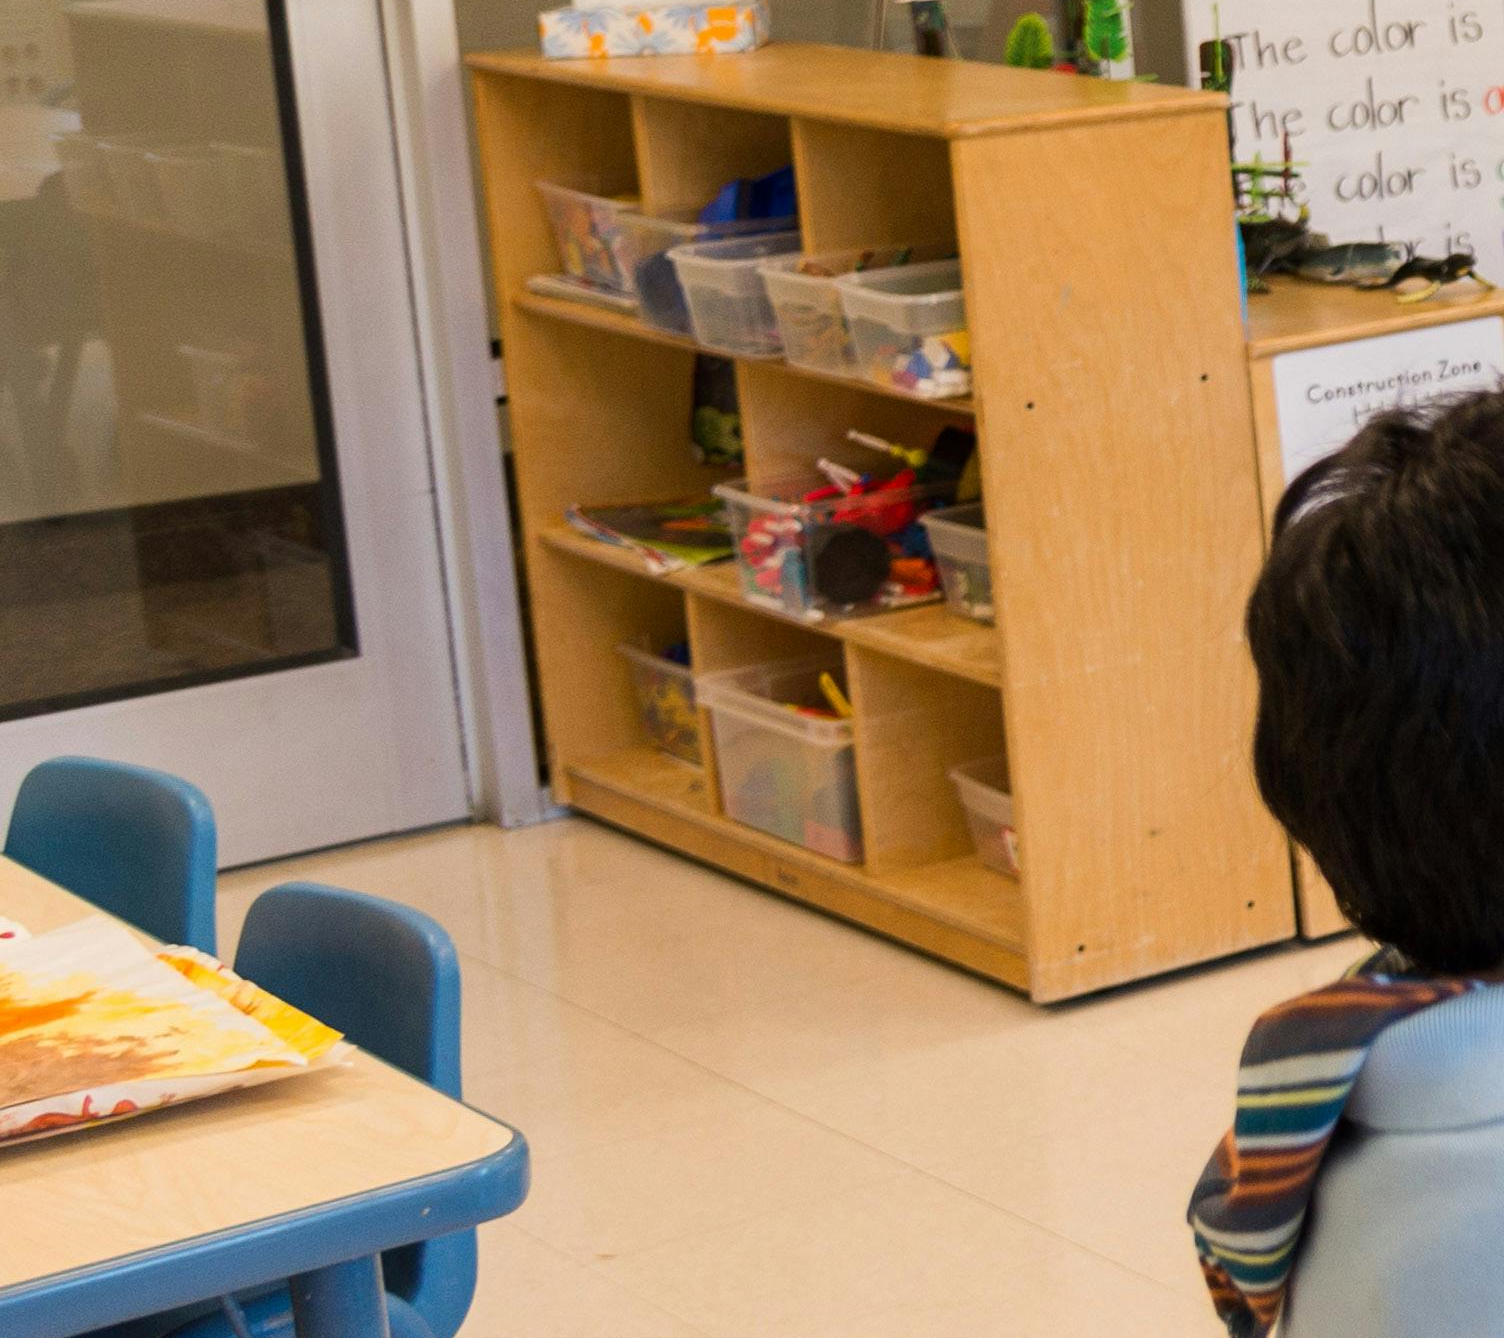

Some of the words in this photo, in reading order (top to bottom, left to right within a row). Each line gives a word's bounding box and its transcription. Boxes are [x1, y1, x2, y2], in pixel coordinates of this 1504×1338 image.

[1228, 31, 1309, 69] The
[1448, 2, 1484, 44] is
[1327, 76, 1420, 132] color
[1440, 80, 1472, 121] is
[1334, 151, 1431, 203] color
[1449, 154, 1482, 189] is
[1307, 370, 1432, 404] Construction
[1437, 359, 1482, 382] Zone
